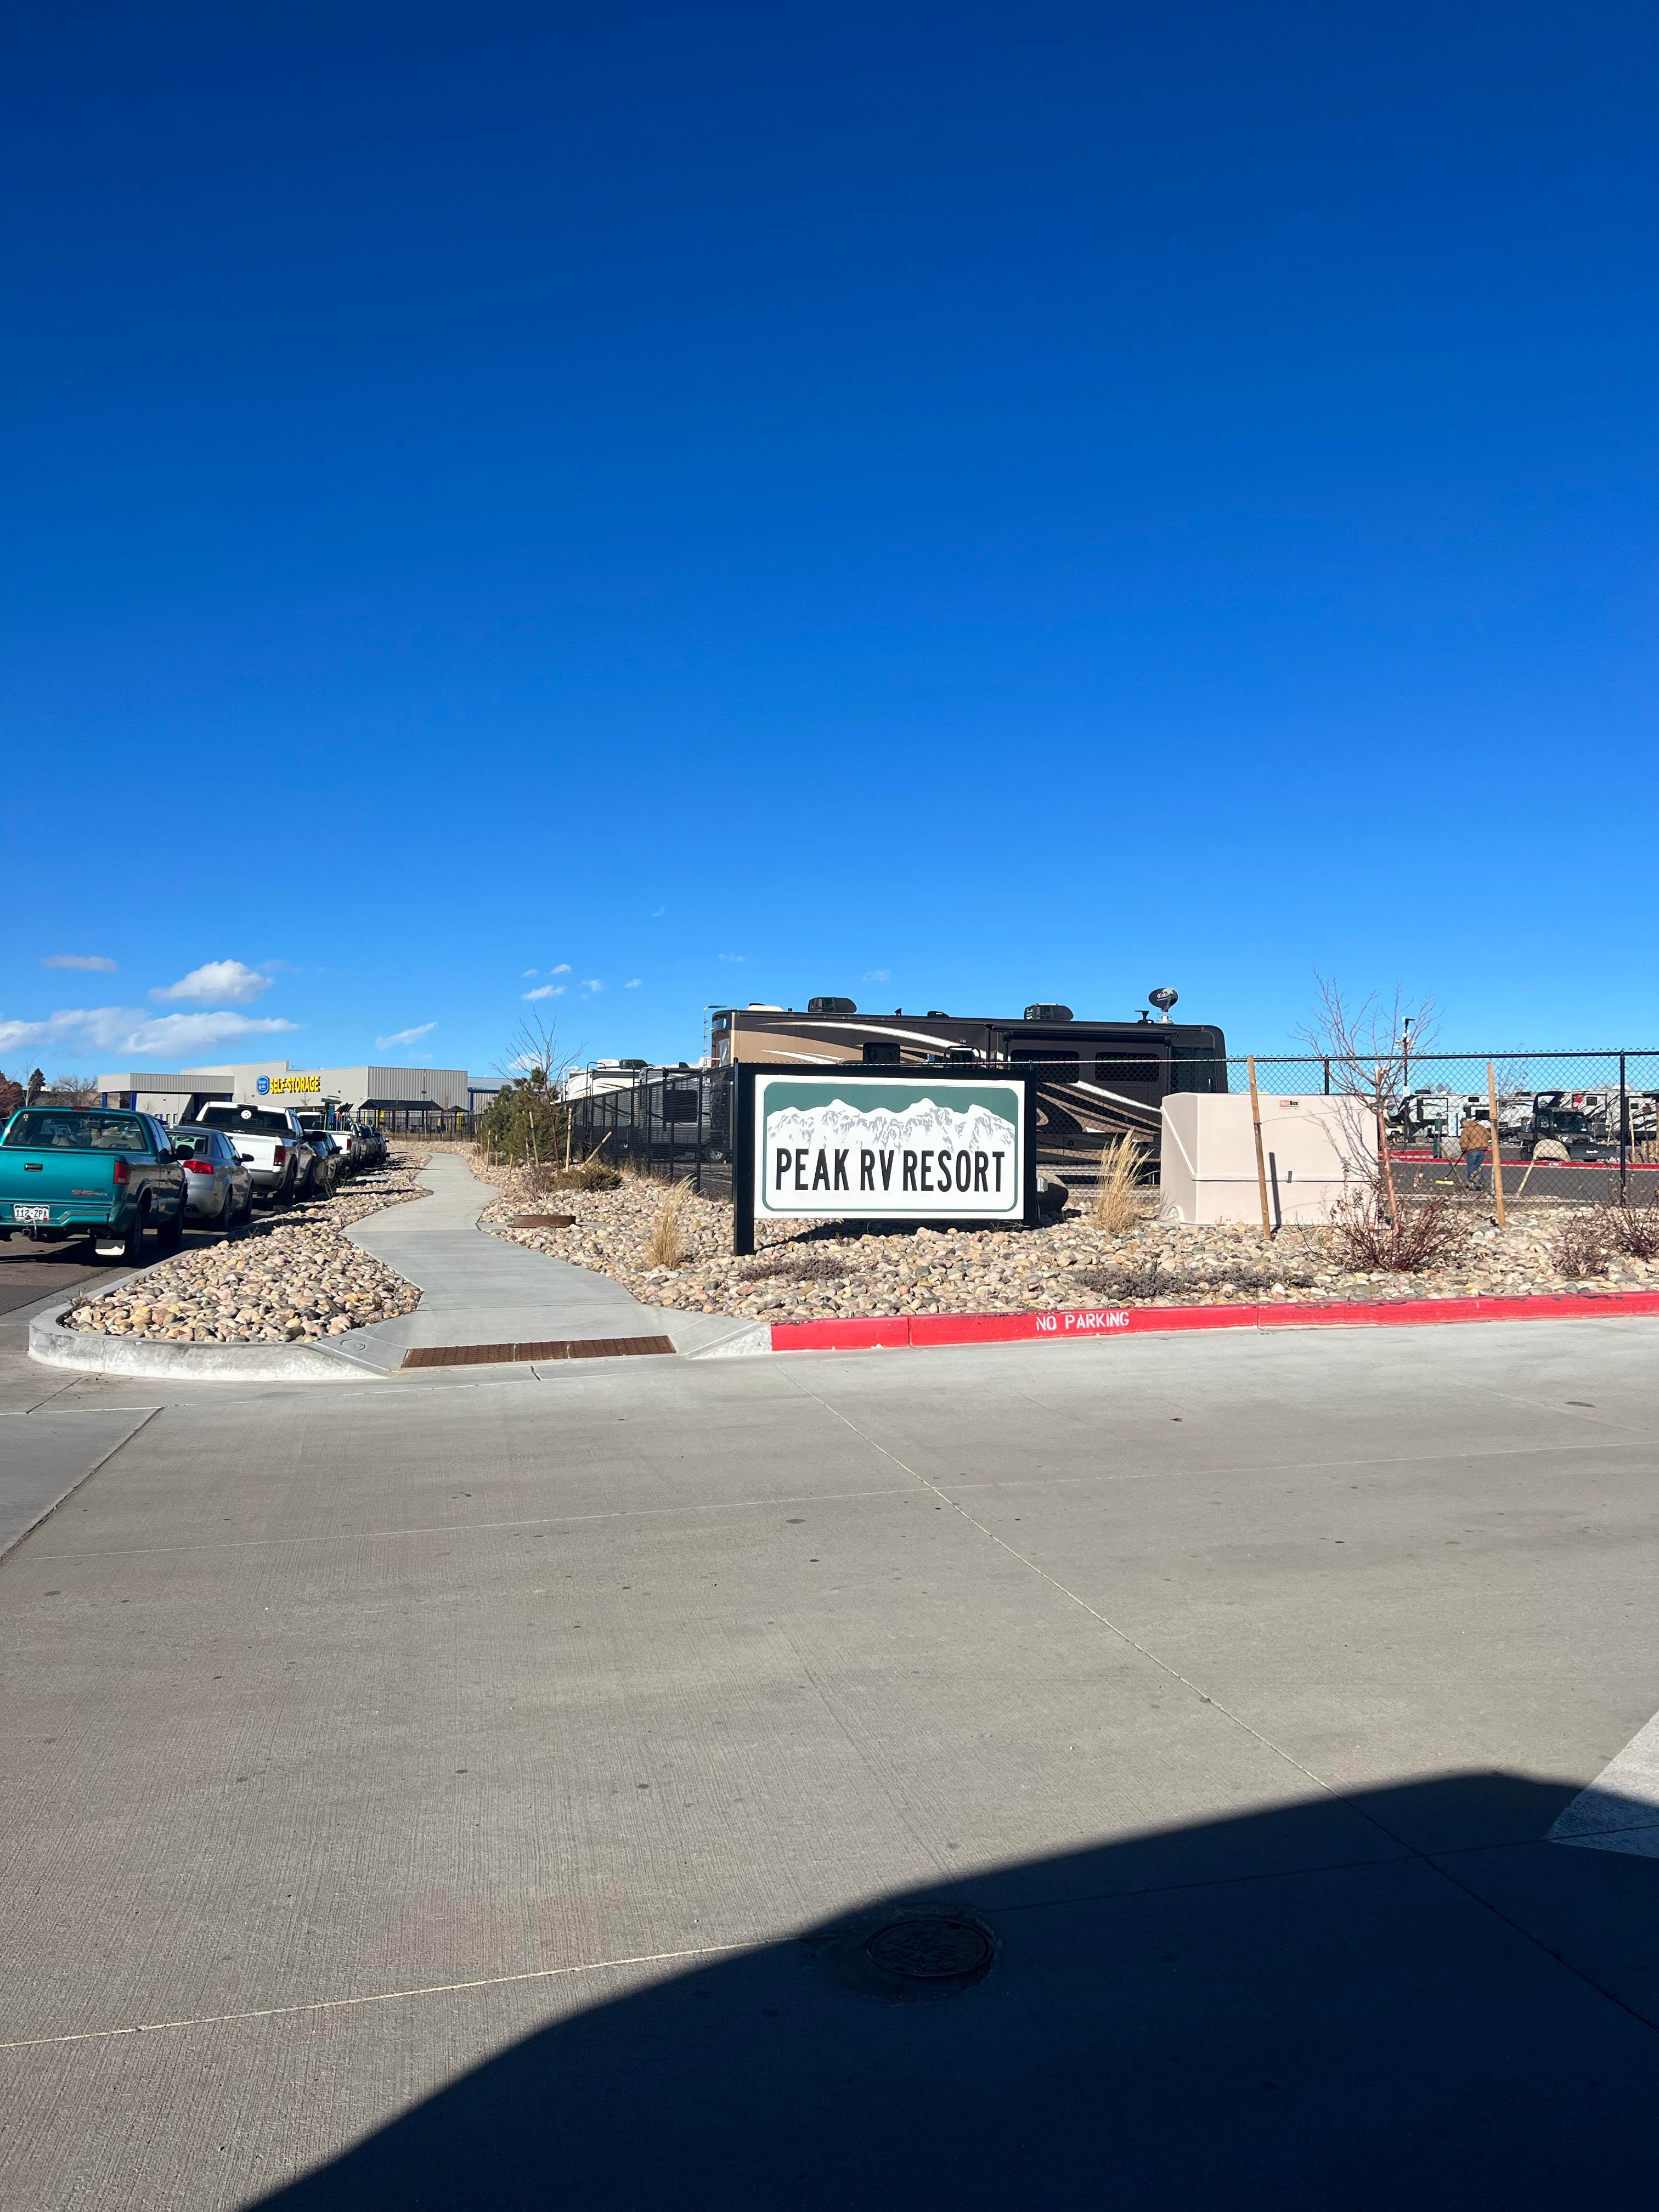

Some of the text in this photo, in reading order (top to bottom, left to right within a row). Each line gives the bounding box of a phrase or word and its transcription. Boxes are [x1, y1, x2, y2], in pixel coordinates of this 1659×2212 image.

[269, 1076, 320, 1094] SELF-STORAGE
[775, 1147, 1006, 1193] PEAK RV RESORT
[1036, 1312, 1130, 1331] NO PARKING
